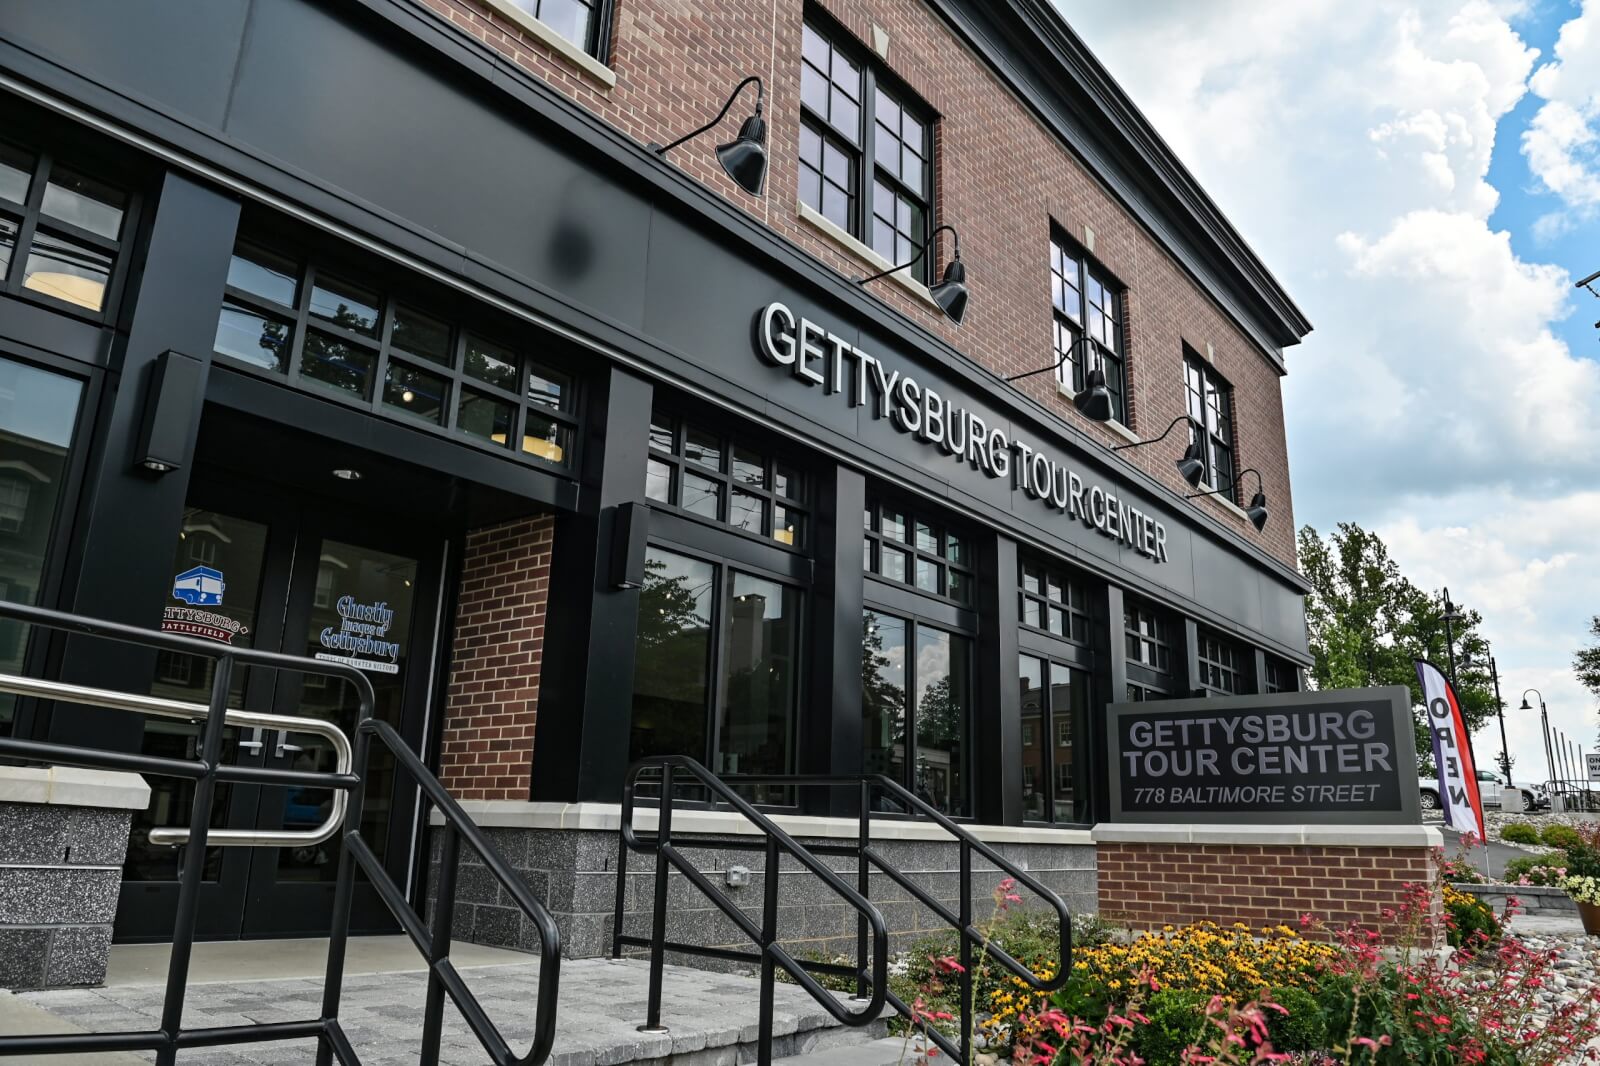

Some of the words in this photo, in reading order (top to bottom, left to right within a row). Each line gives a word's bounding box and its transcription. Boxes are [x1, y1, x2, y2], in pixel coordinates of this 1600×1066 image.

[760, 302, 1008, 478] GETTYSBURG
[1012, 440, 1086, 520] TOUR
[1089, 485, 1169, 563] CENTER
[163, 607, 241, 632] TTYSBURG
[341, 617, 376, 637] Images
[320, 627, 399, 663] Gettysburg
[1129, 709, 1375, 748] GETTYSBURG
[1122, 749, 1221, 777] TOUR
[1231, 742, 1393, 775] CENTER
[1133, 787, 1165, 804] 778
[1170, 785, 1286, 804] BALTIMORE
[1291, 784, 1381, 803] STREET
